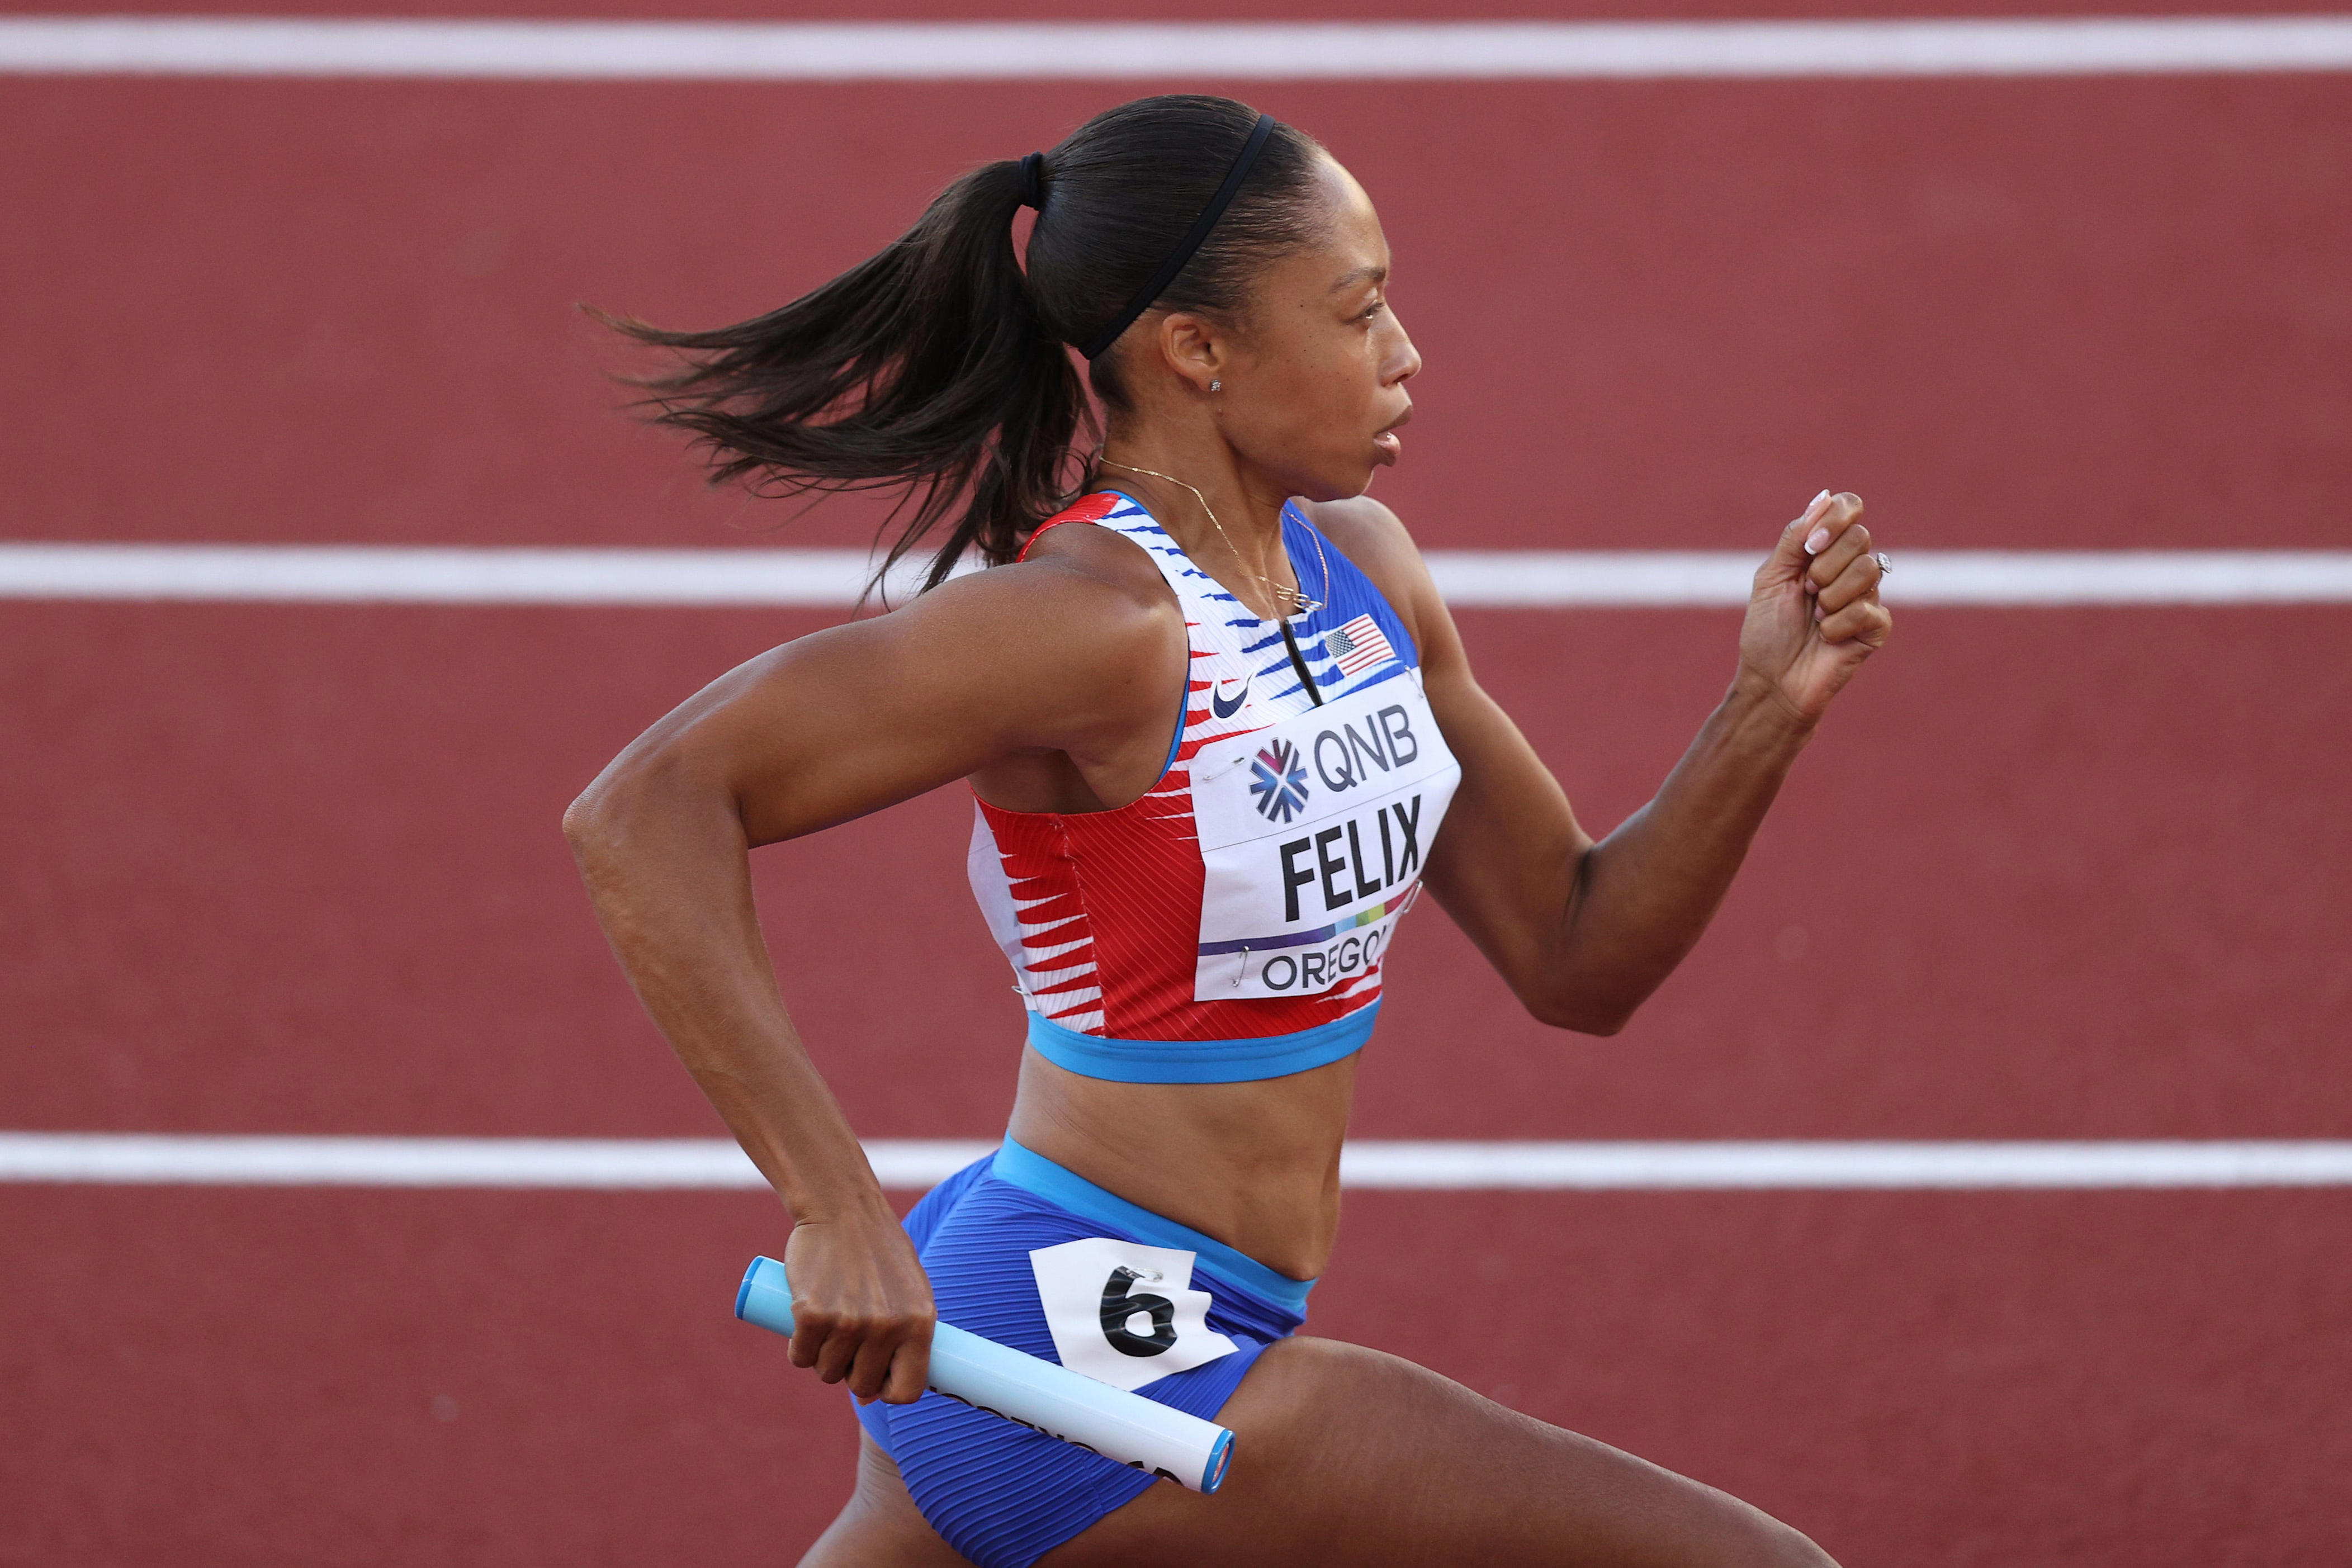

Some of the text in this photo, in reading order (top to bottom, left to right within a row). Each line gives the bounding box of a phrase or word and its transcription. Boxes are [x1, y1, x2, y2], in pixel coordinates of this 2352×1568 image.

[1314, 704, 1418, 793] QNB
[1279, 794, 1421, 922] FELIX
[1261, 925, 1387, 991] OREGO
[1099, 1266, 1178, 1357] 6
